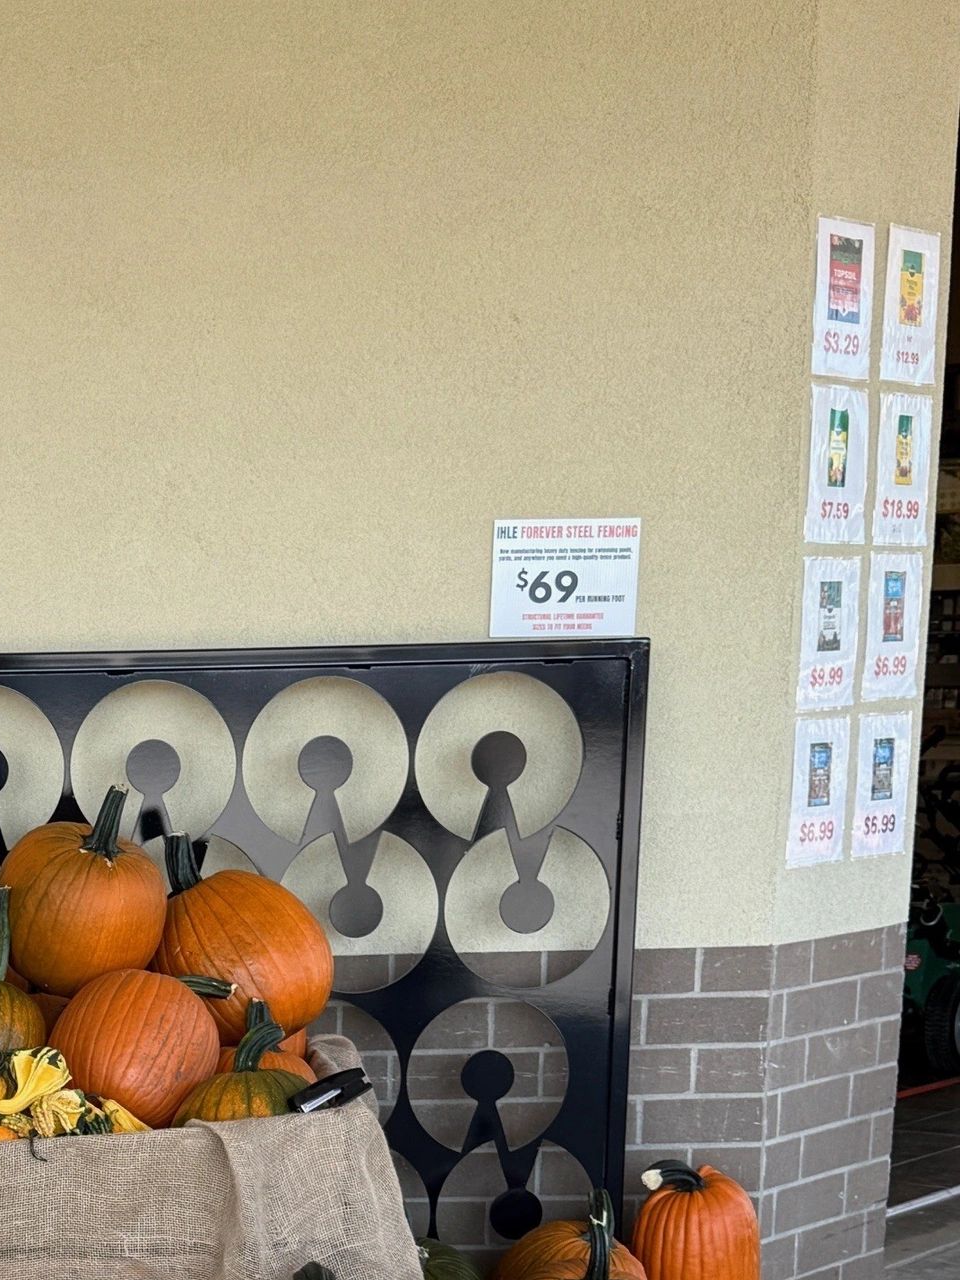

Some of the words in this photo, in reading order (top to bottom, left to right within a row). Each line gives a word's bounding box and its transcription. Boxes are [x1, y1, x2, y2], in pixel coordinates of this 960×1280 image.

[823, 331, 860, 357] $3.29
[896, 350, 920, 365] $12.99
[820, 499, 849, 520] $7.59
[882, 497, 919, 520] $18.99
[497, 526, 518, 539] IHLE
[521, 526, 563, 539] FOREVER
[565, 525, 595, 538] STEEL
[597, 525, 638, 538] FENCING
[515, 567, 579, 604] $69
[575, 595, 585, 603] PER
[611, 594, 625, 602] FOOT
[809, 666, 843, 688] $9.99
[874, 654, 907, 680] $6.99
[799, 820, 834, 846] $6.99
